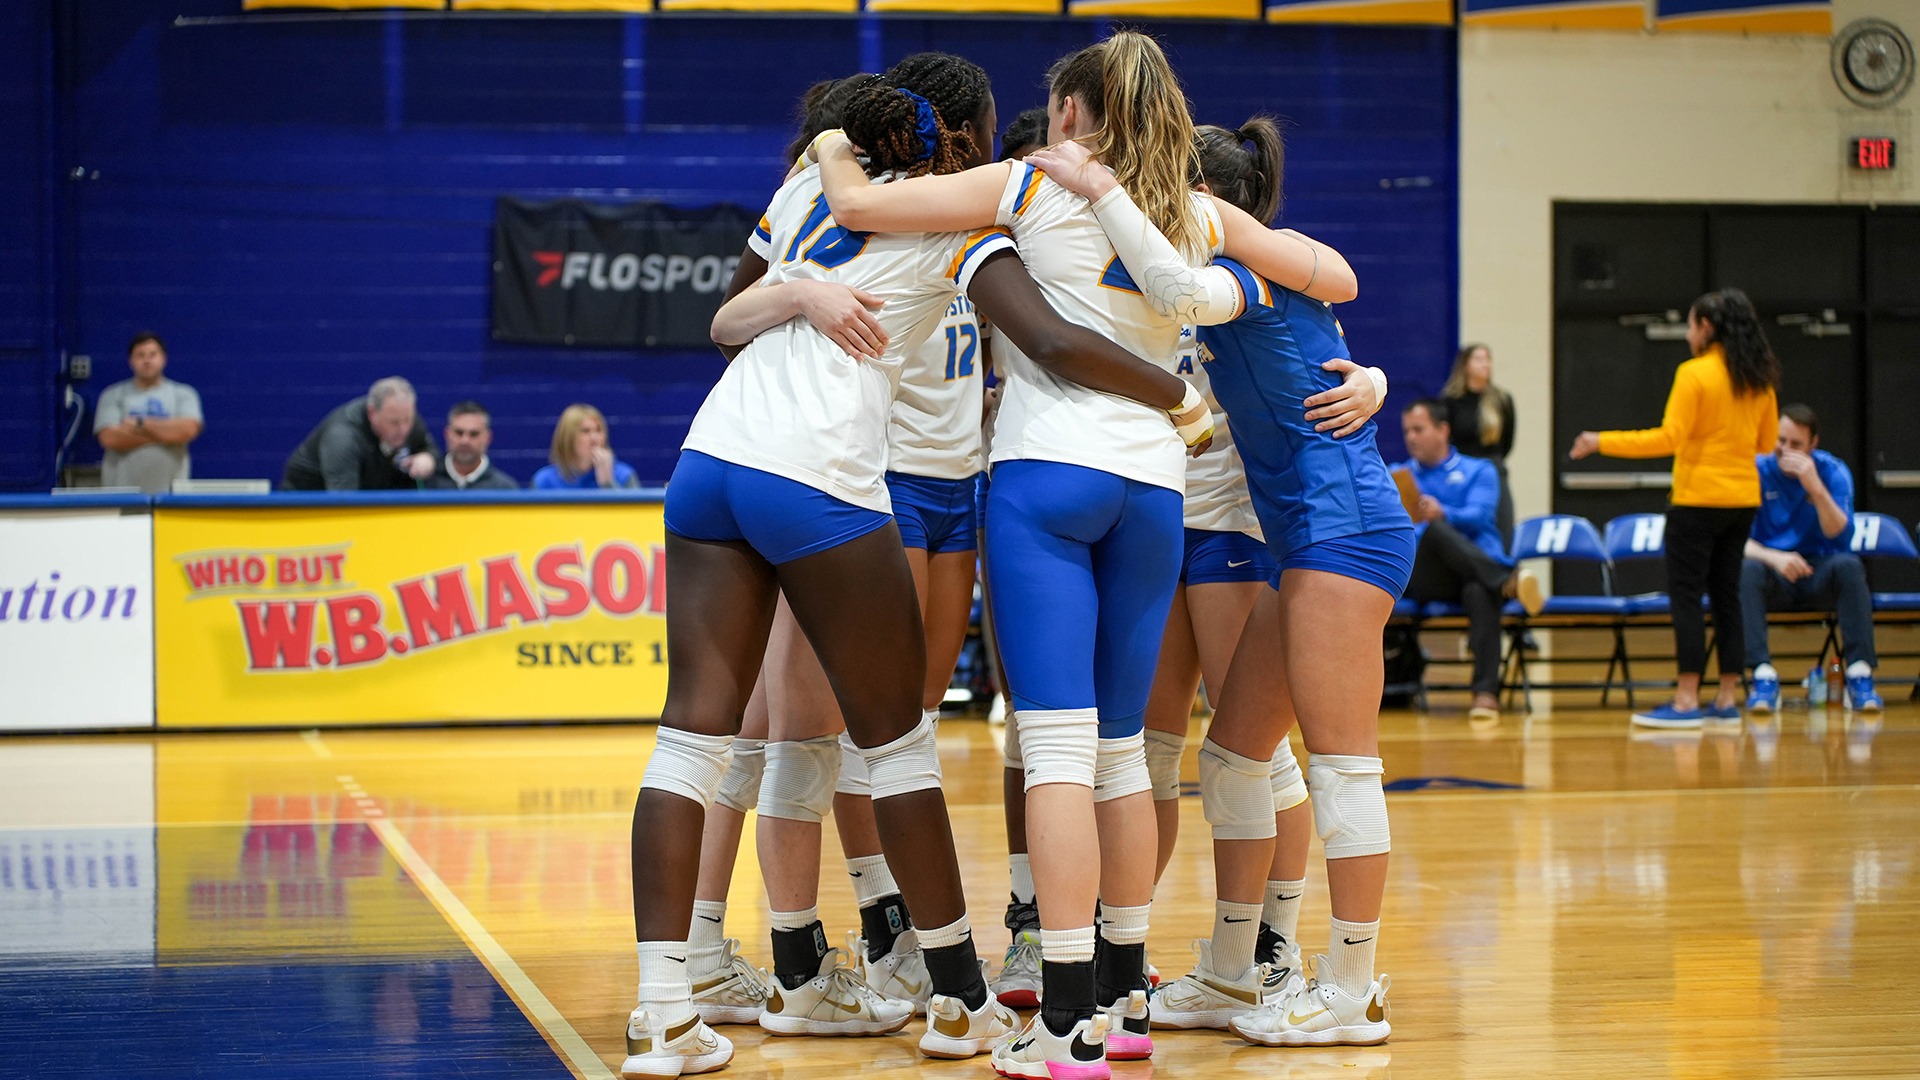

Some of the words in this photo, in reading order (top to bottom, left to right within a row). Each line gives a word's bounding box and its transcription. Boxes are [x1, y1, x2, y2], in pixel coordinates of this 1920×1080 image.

[1859, 137, 1891, 168] EXIT
[944, 322, 977, 382] 12
[1536, 518, 1573, 553] H
[1631, 517, 1666, 552] H
[1850, 515, 1880, 551] H
[184, 556, 266, 591] WHO
[276, 553, 346, 586] BUT
[517, 641, 633, 667] SINCE
